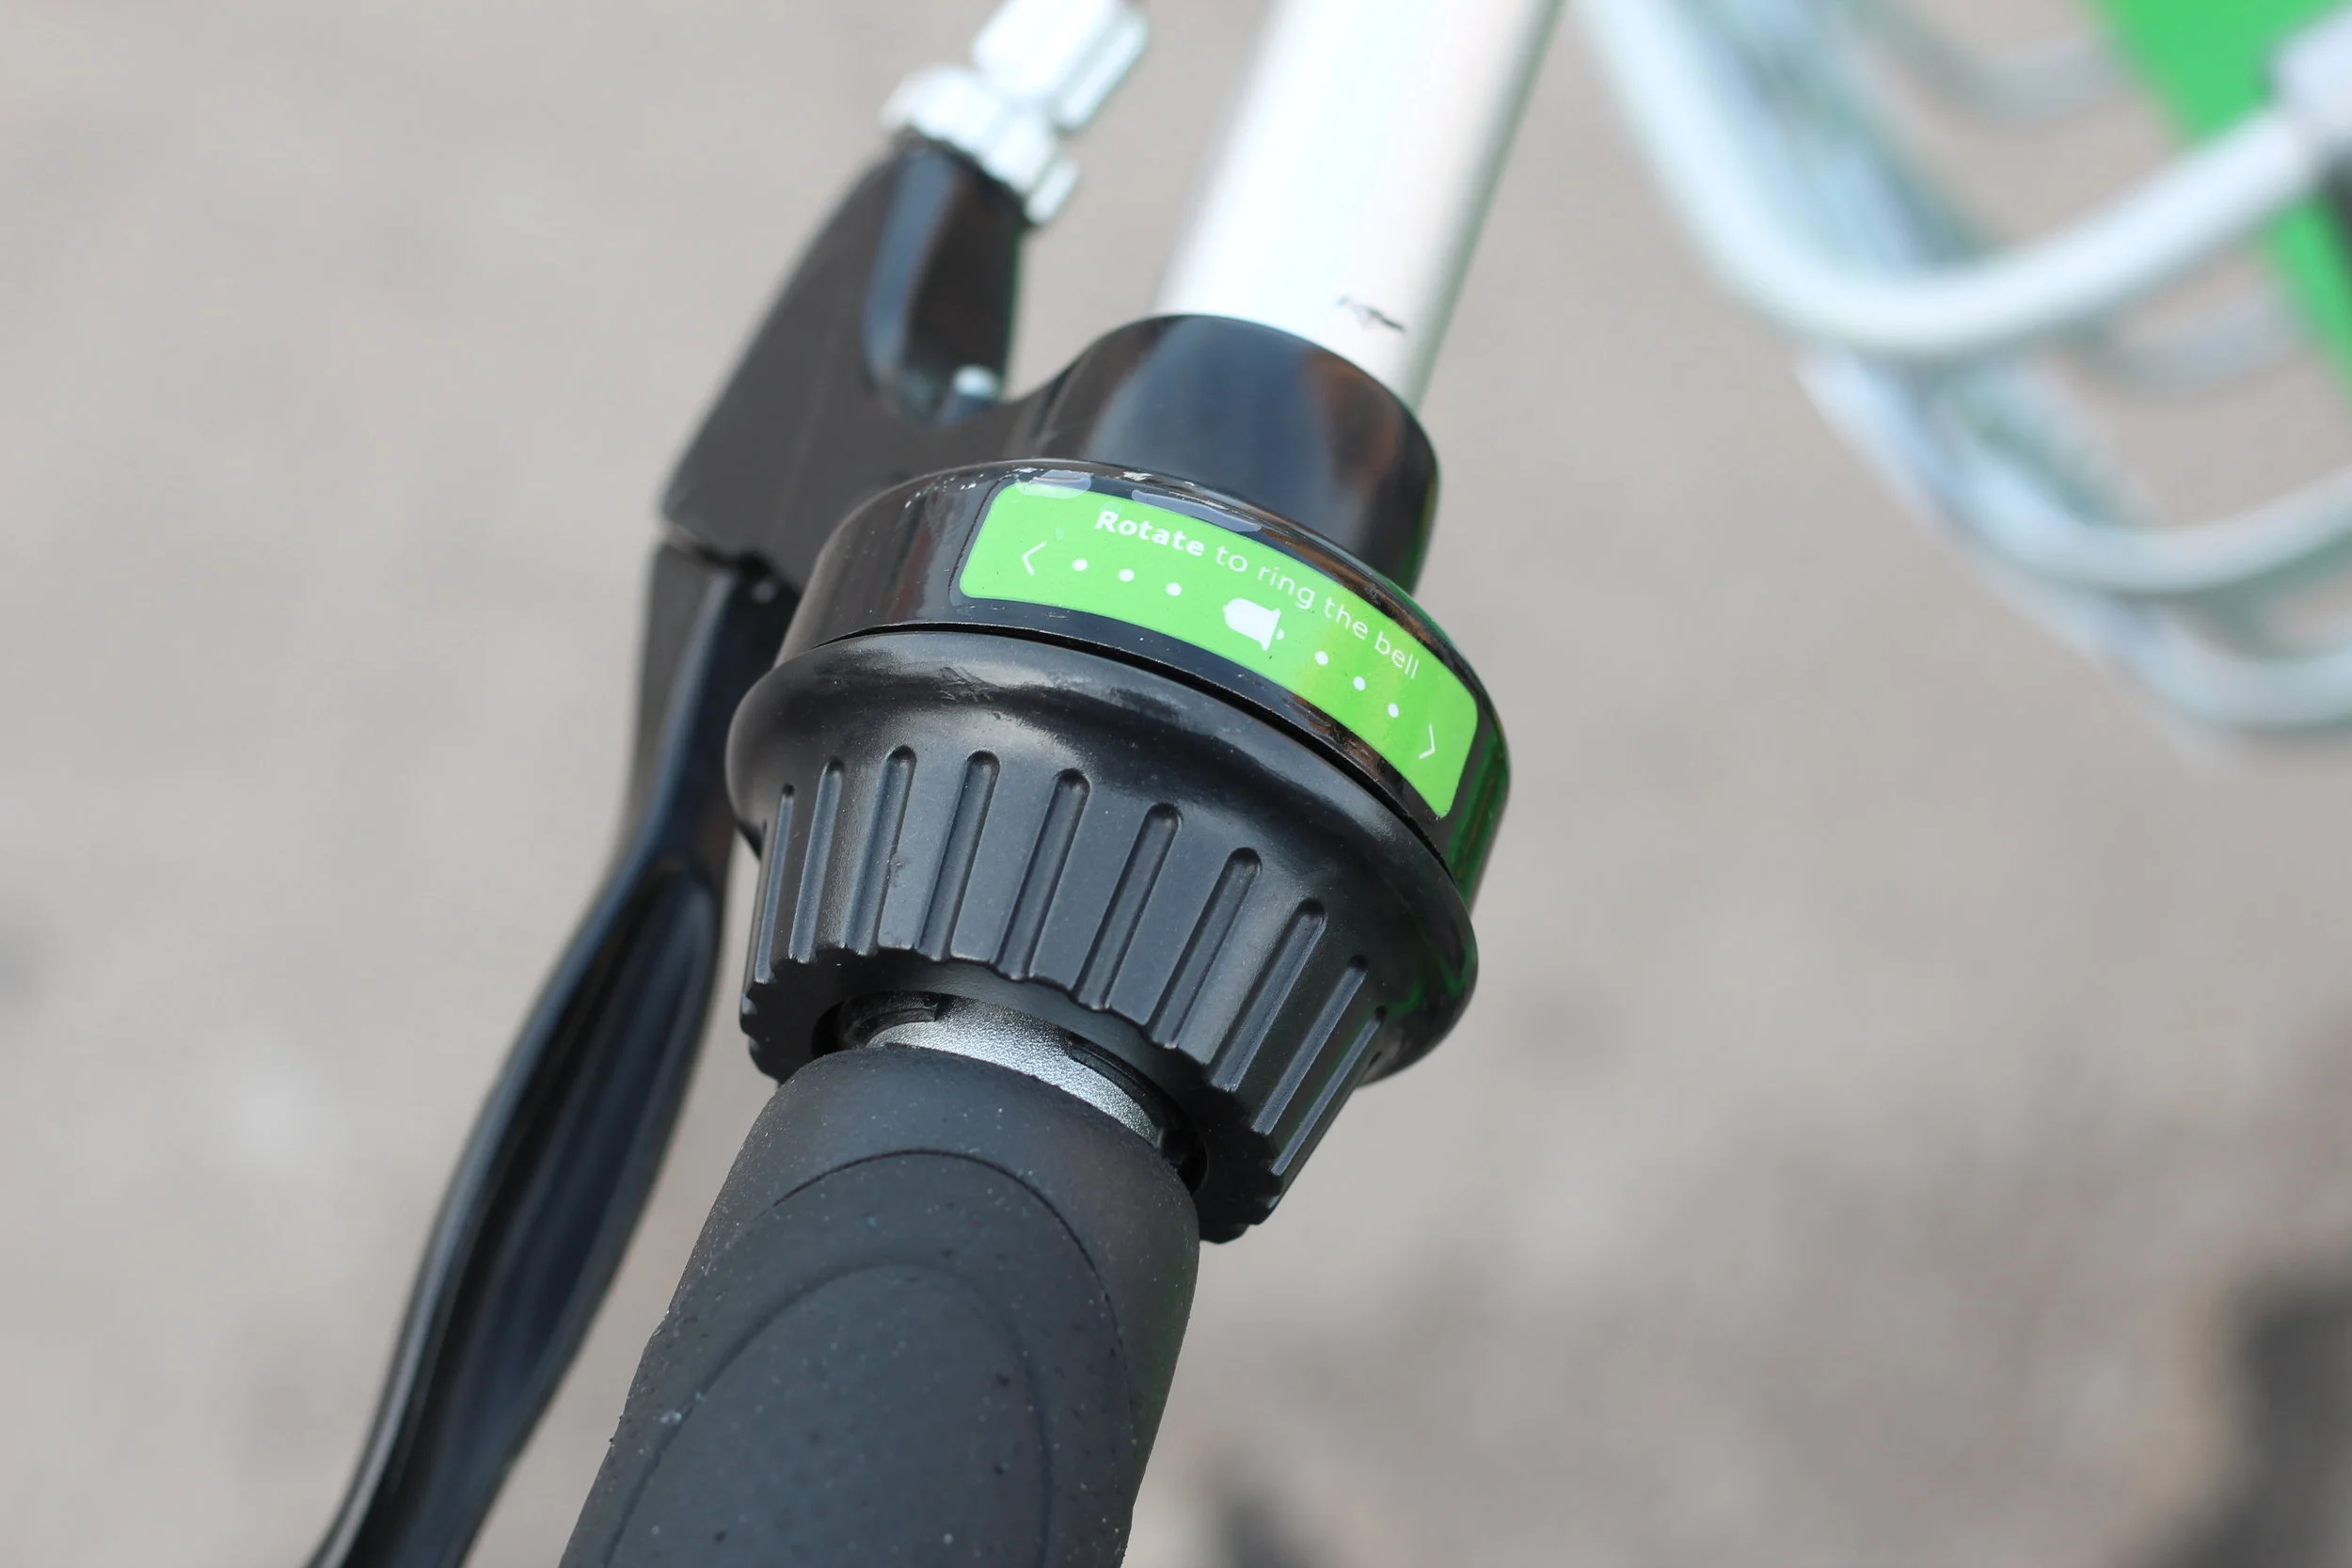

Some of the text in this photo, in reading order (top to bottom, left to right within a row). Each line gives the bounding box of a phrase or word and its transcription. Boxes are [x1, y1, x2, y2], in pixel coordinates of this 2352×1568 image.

[1094, 509, 1420, 680] Rotate to ring the bell
